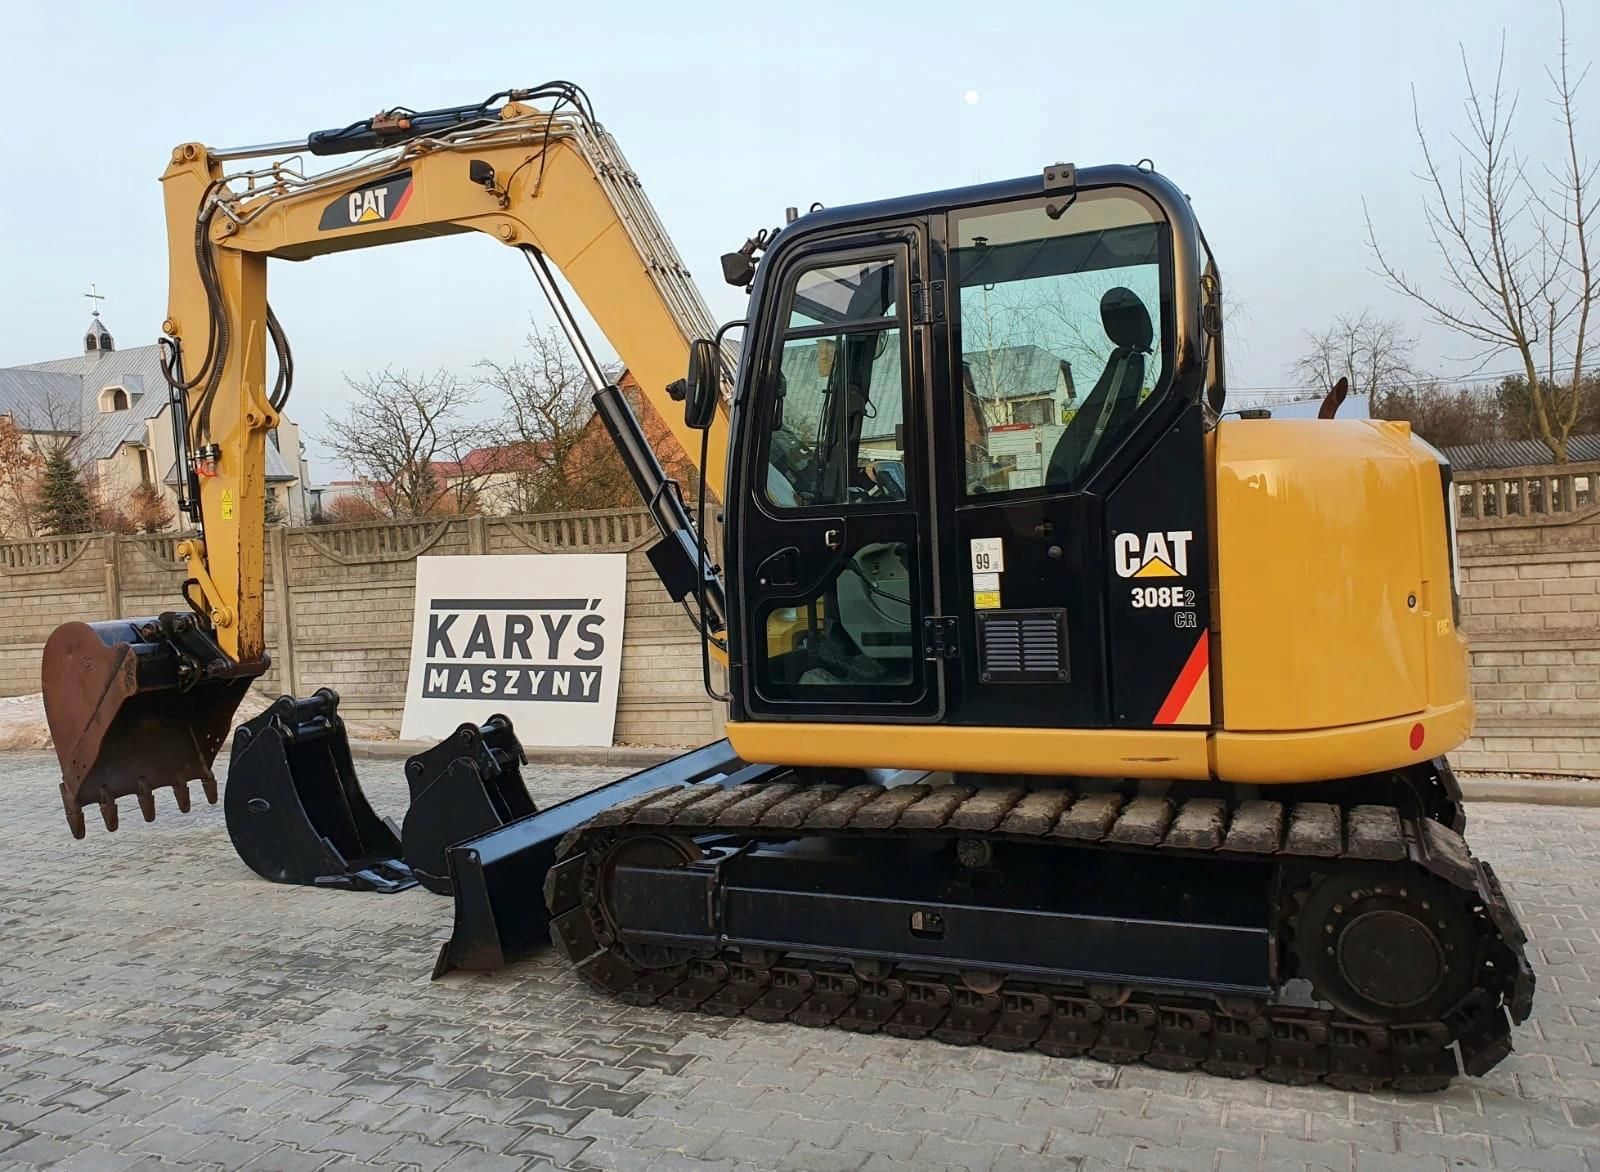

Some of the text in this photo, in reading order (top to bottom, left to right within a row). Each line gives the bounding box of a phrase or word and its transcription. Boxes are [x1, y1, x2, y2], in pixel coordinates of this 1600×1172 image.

[348, 187, 388, 223] CAT
[976, 553, 990, 570] 99
[1114, 530, 1193, 578] CAT
[1131, 586, 1196, 608] 308E2
[426, 598, 606, 661] KARYŚ
[1174, 611, 1197, 628] CR
[427, 668, 598, 697] MASZYNY
